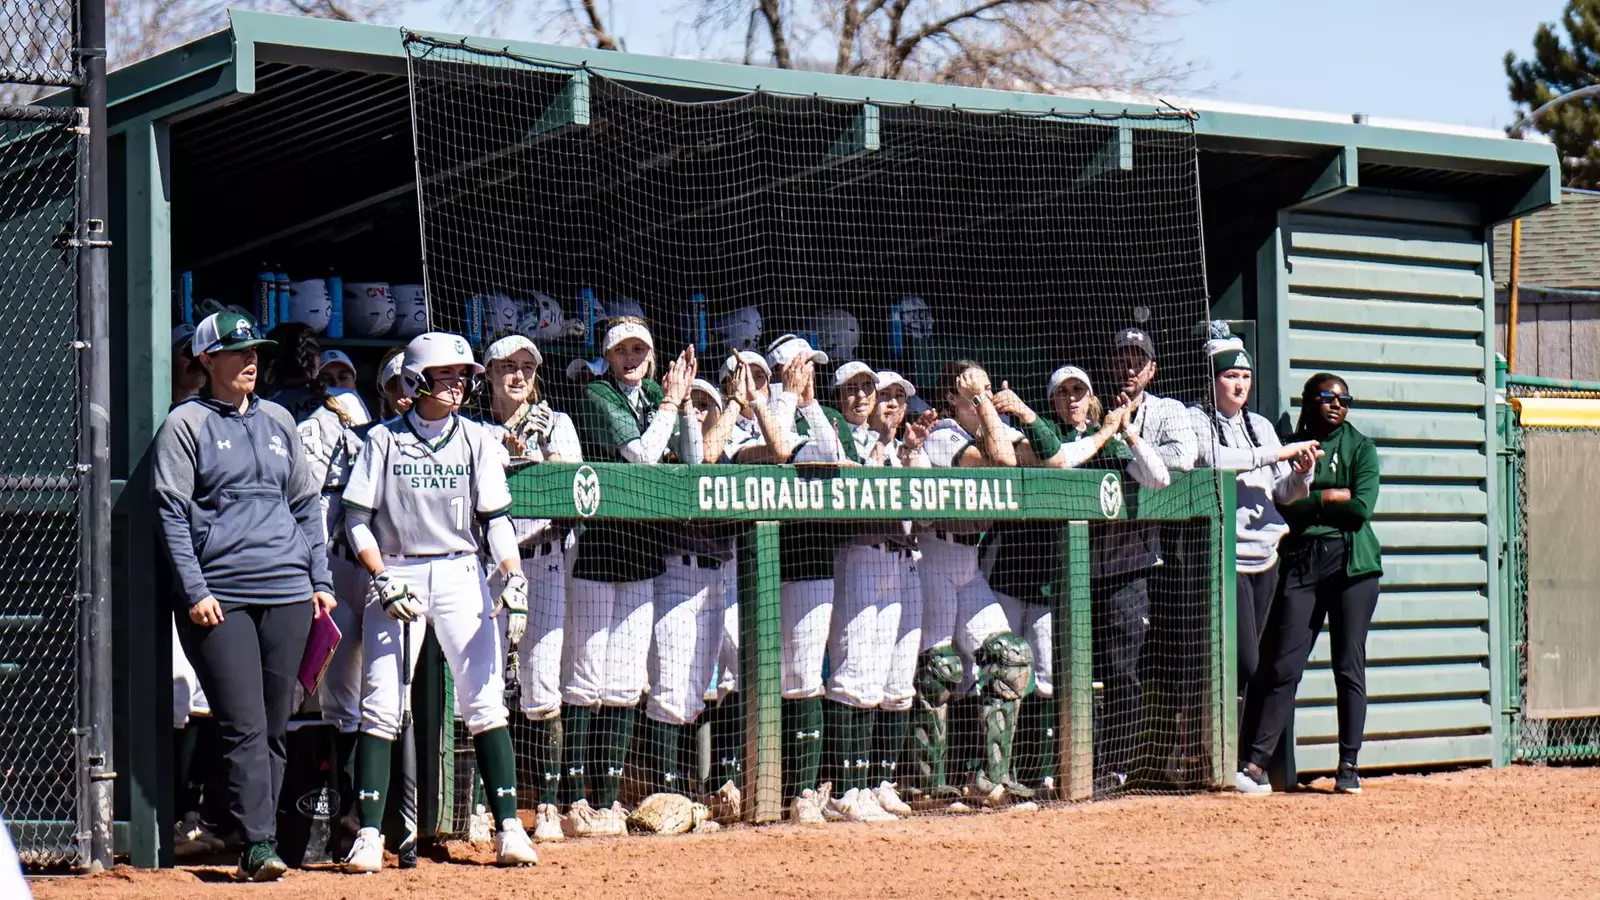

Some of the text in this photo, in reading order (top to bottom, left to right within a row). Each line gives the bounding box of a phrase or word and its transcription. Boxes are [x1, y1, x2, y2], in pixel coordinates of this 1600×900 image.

[411, 477, 458, 489] STATE
[698, 476, 1019, 511] COLORADO STATE SOFTBALL
[450, 496, 471, 531] 1
